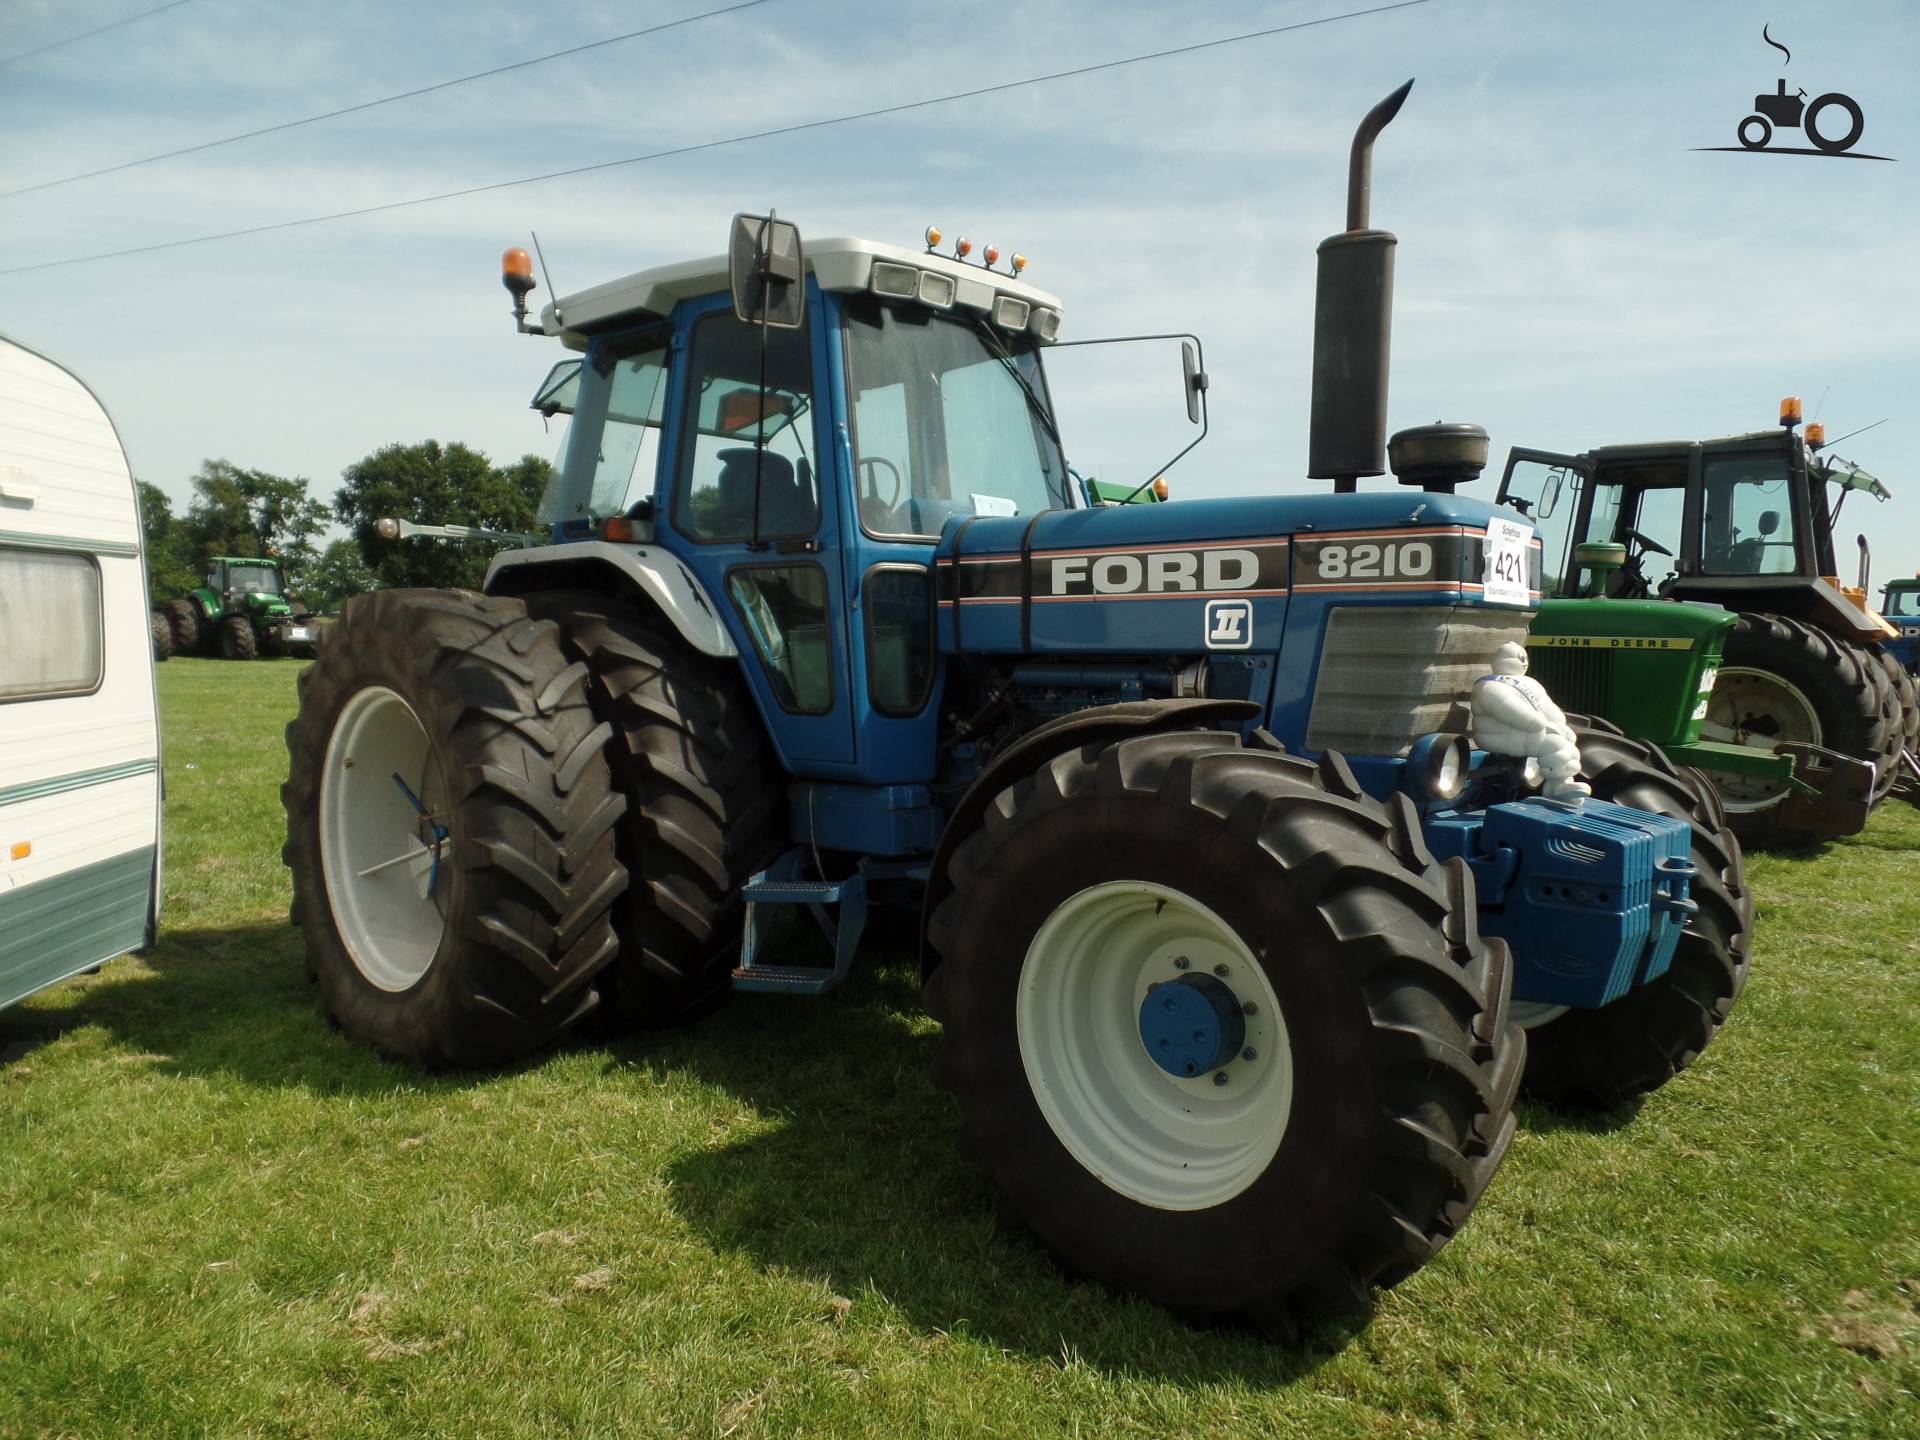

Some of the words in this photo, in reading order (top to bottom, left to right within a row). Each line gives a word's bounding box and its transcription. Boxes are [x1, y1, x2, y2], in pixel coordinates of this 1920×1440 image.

[1051, 549, 1259, 594] FORD
[1318, 543, 1432, 578] 8210
[1495, 551, 1522, 583] 421
[1548, 638, 1591, 646] JOHN
[1611, 639, 1669, 648] DEERE
